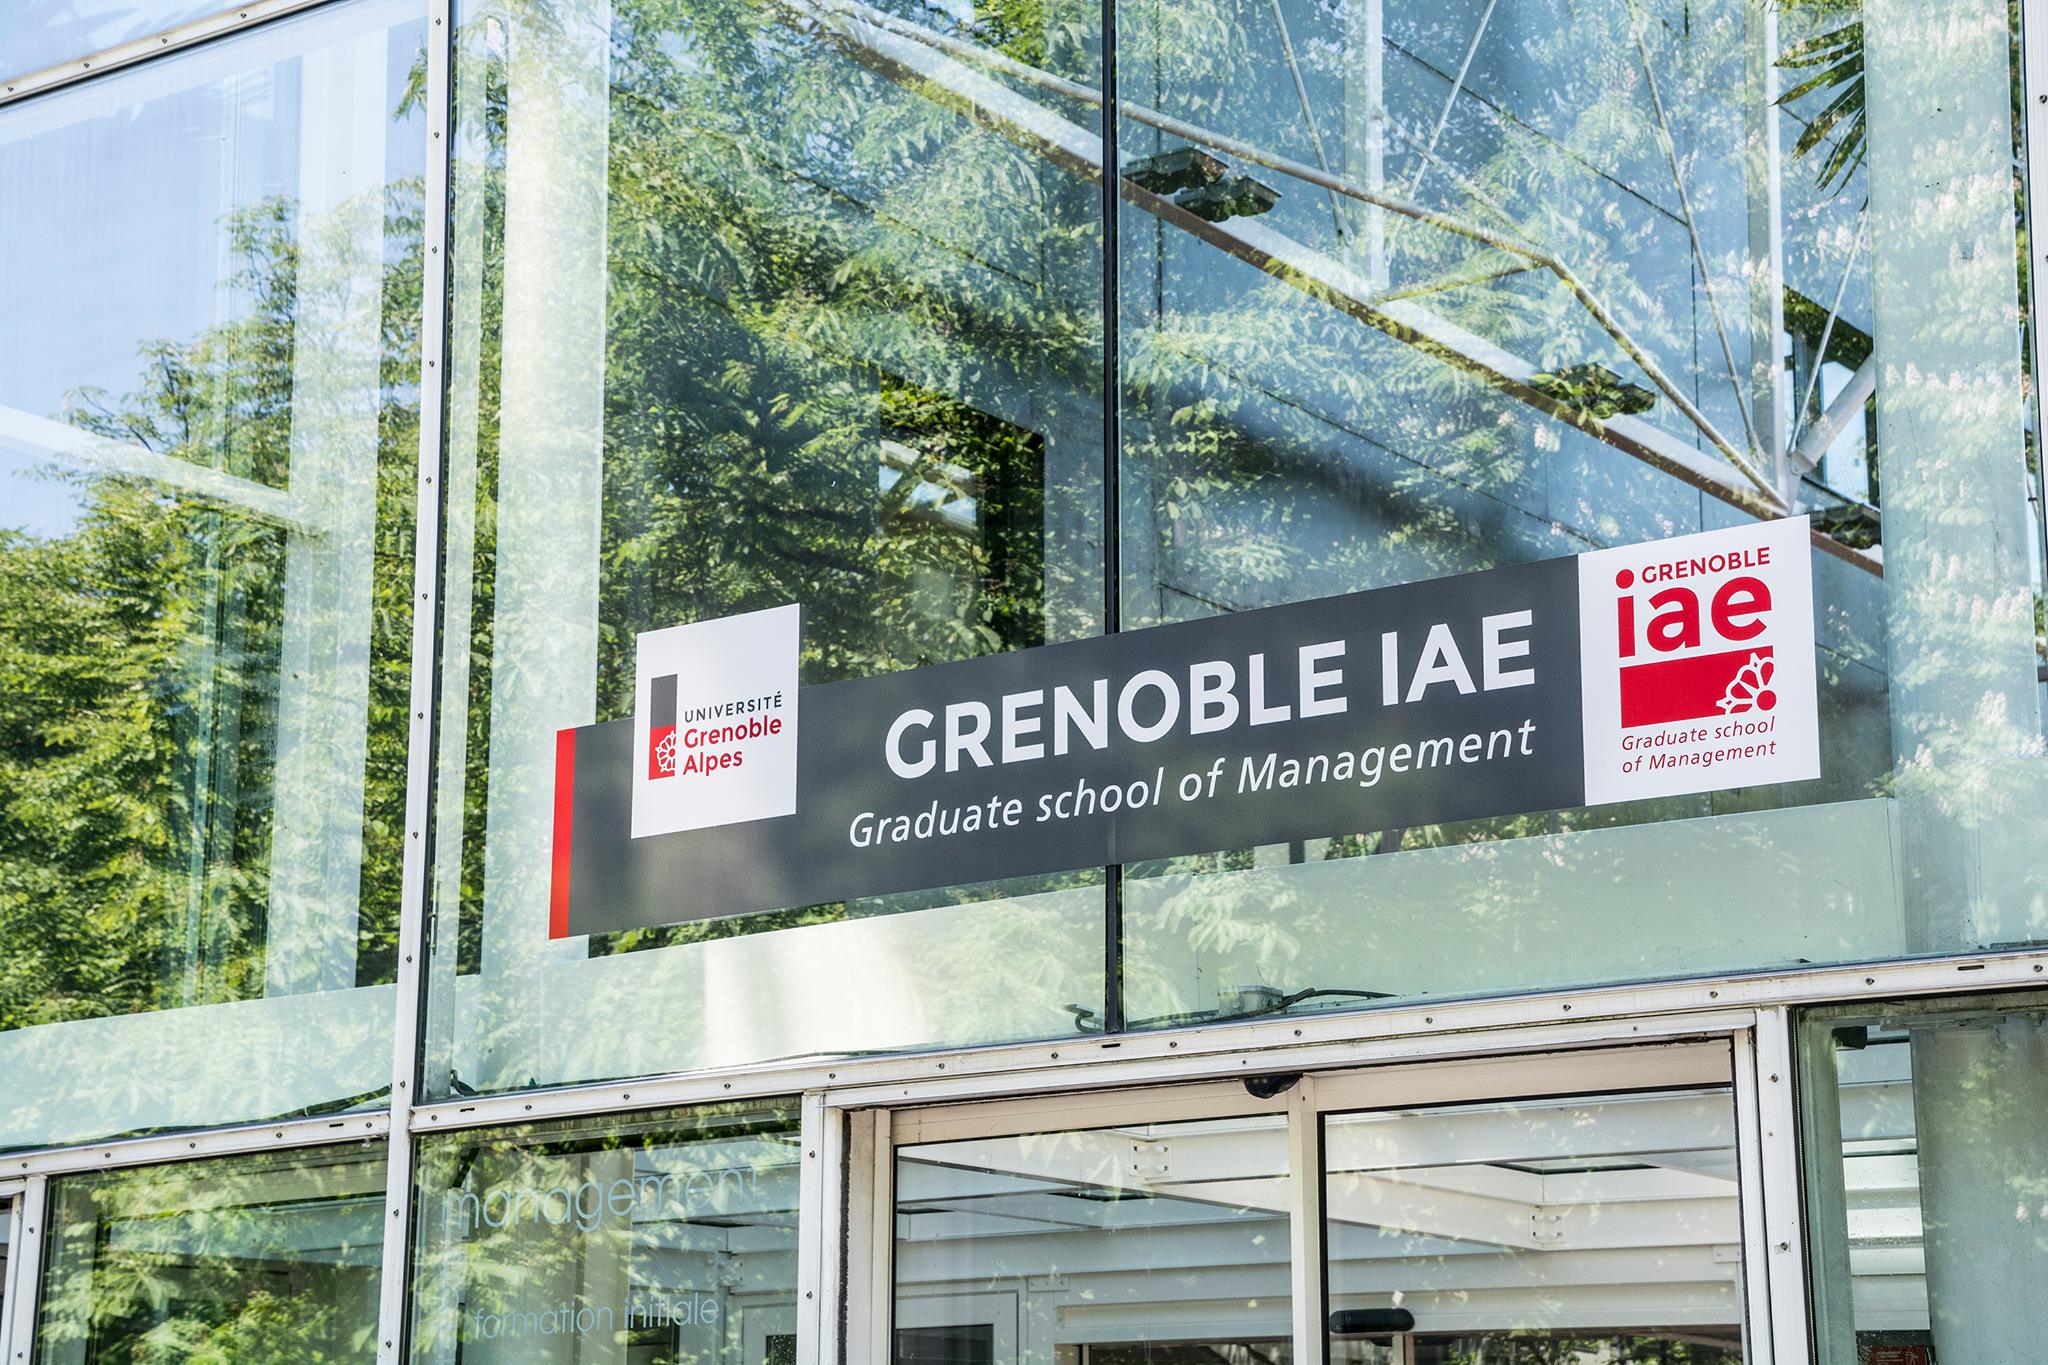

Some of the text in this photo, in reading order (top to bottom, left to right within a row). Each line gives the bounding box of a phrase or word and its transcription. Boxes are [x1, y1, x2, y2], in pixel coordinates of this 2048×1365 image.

[1642, 547, 1771, 584] GRENOBLE
[1616, 569, 1772, 658] iae
[684, 690, 782, 723] UNIVERSITÉ
[886, 610, 1535, 778] GRENOBLE IAE
[684, 715, 782, 749] Grenoble
[1622, 716, 1775, 751] Graduate school
[683, 750, 743, 777] Alpes
[1622, 740, 1777, 774] of Management
[849, 718, 1536, 848] Graduate school of Management
[474, 1291, 720, 1340] formation initiale
